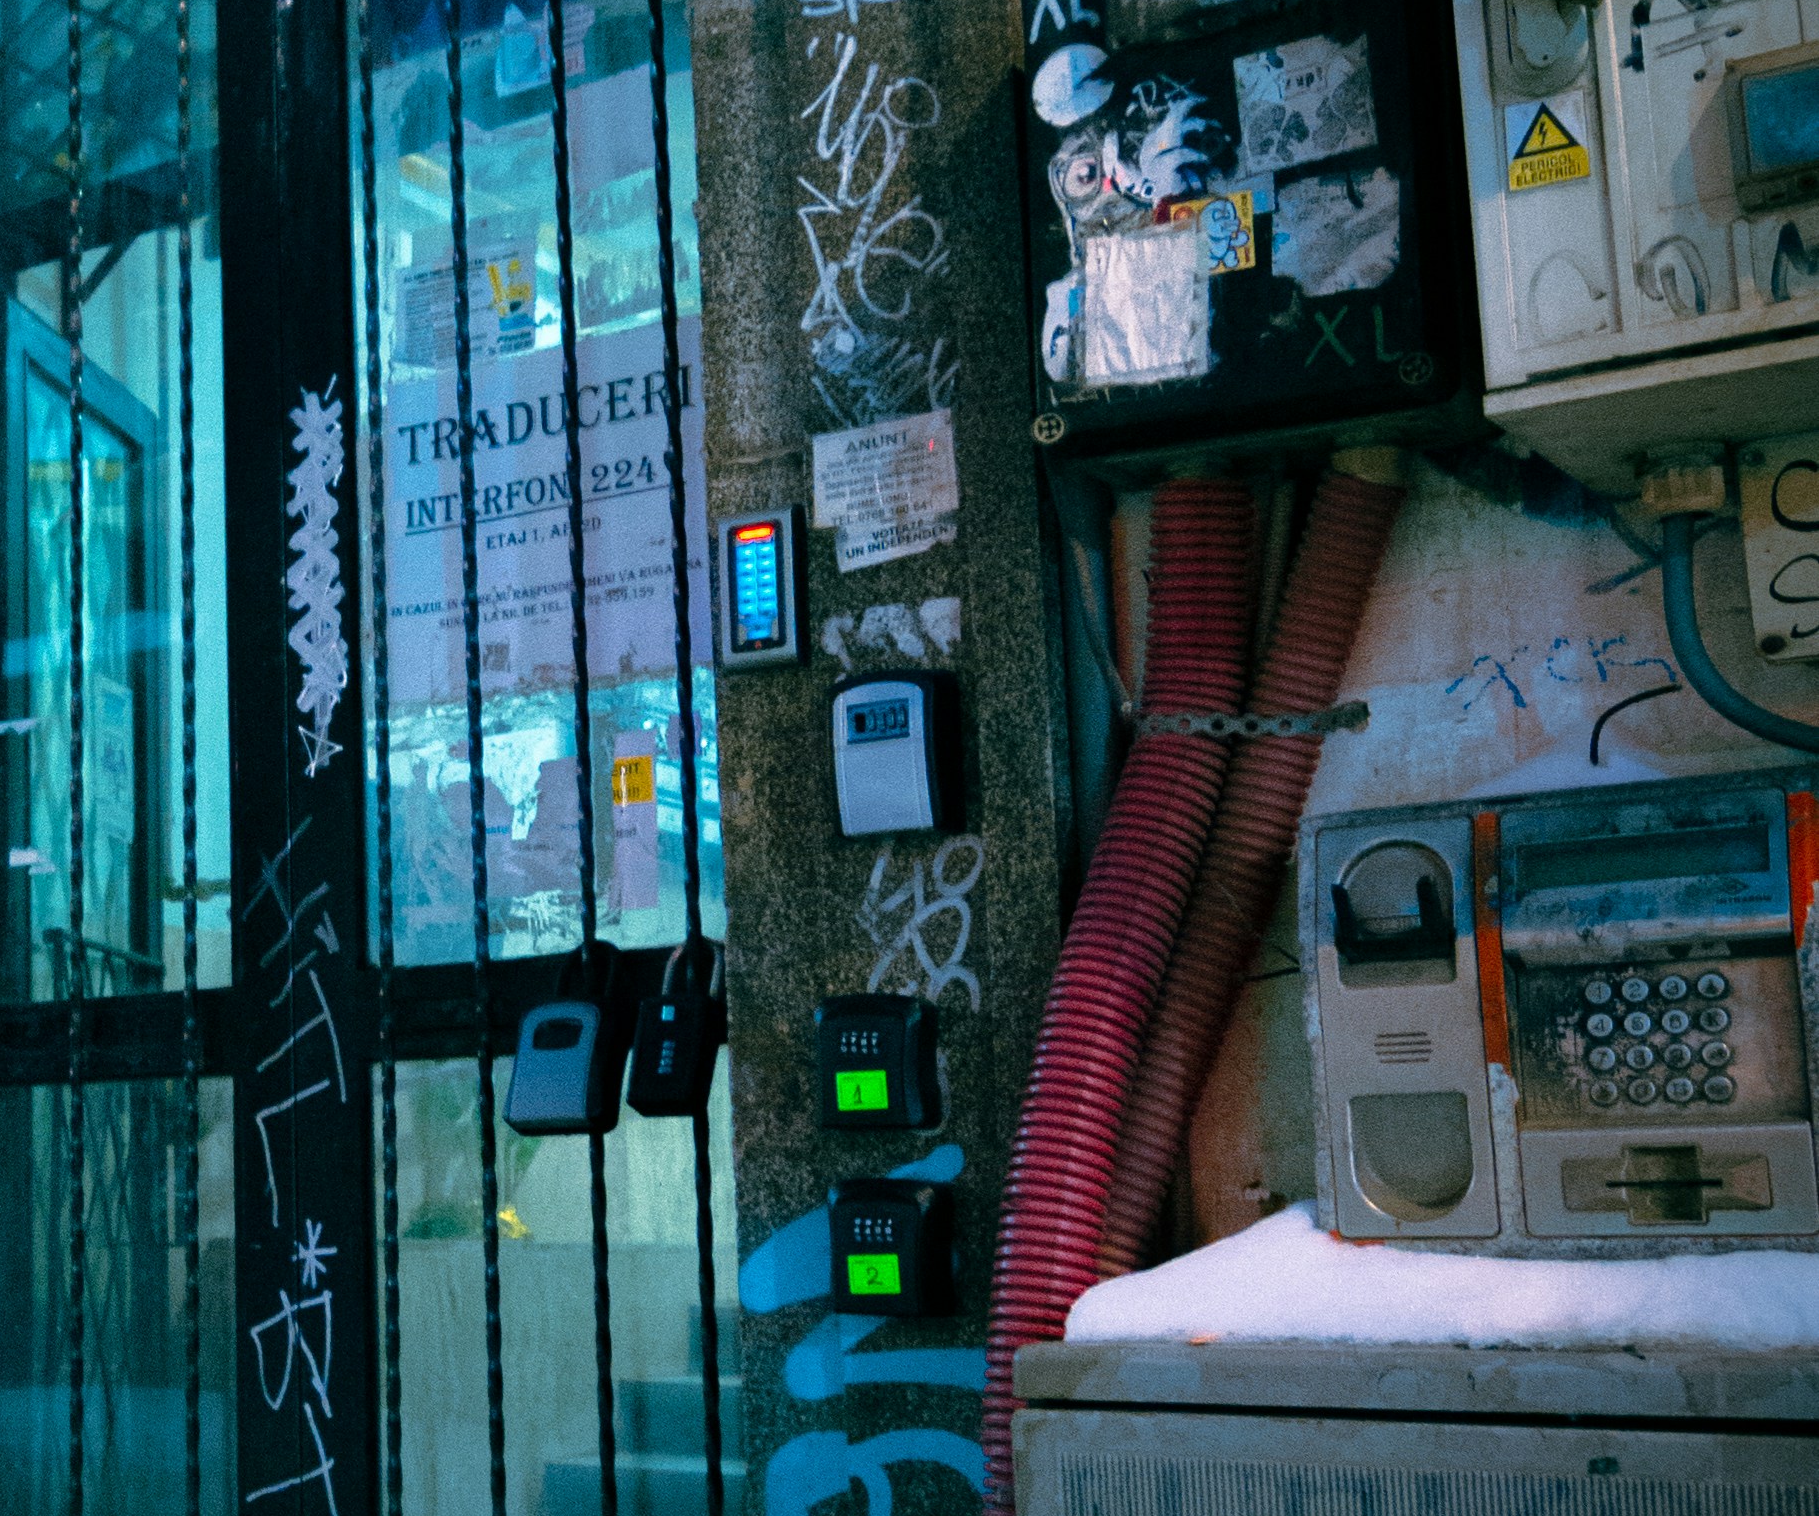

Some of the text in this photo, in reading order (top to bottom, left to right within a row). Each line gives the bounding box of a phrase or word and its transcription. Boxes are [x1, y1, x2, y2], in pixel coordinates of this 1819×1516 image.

[1521, 153, 1572, 172] PERICOL
[398, 365, 694, 466] TRADUCERI
[405, 470, 572, 529] INTRFON
[486, 531, 527, 550] ETAJ
[866, 1266, 883, 1287] 2
